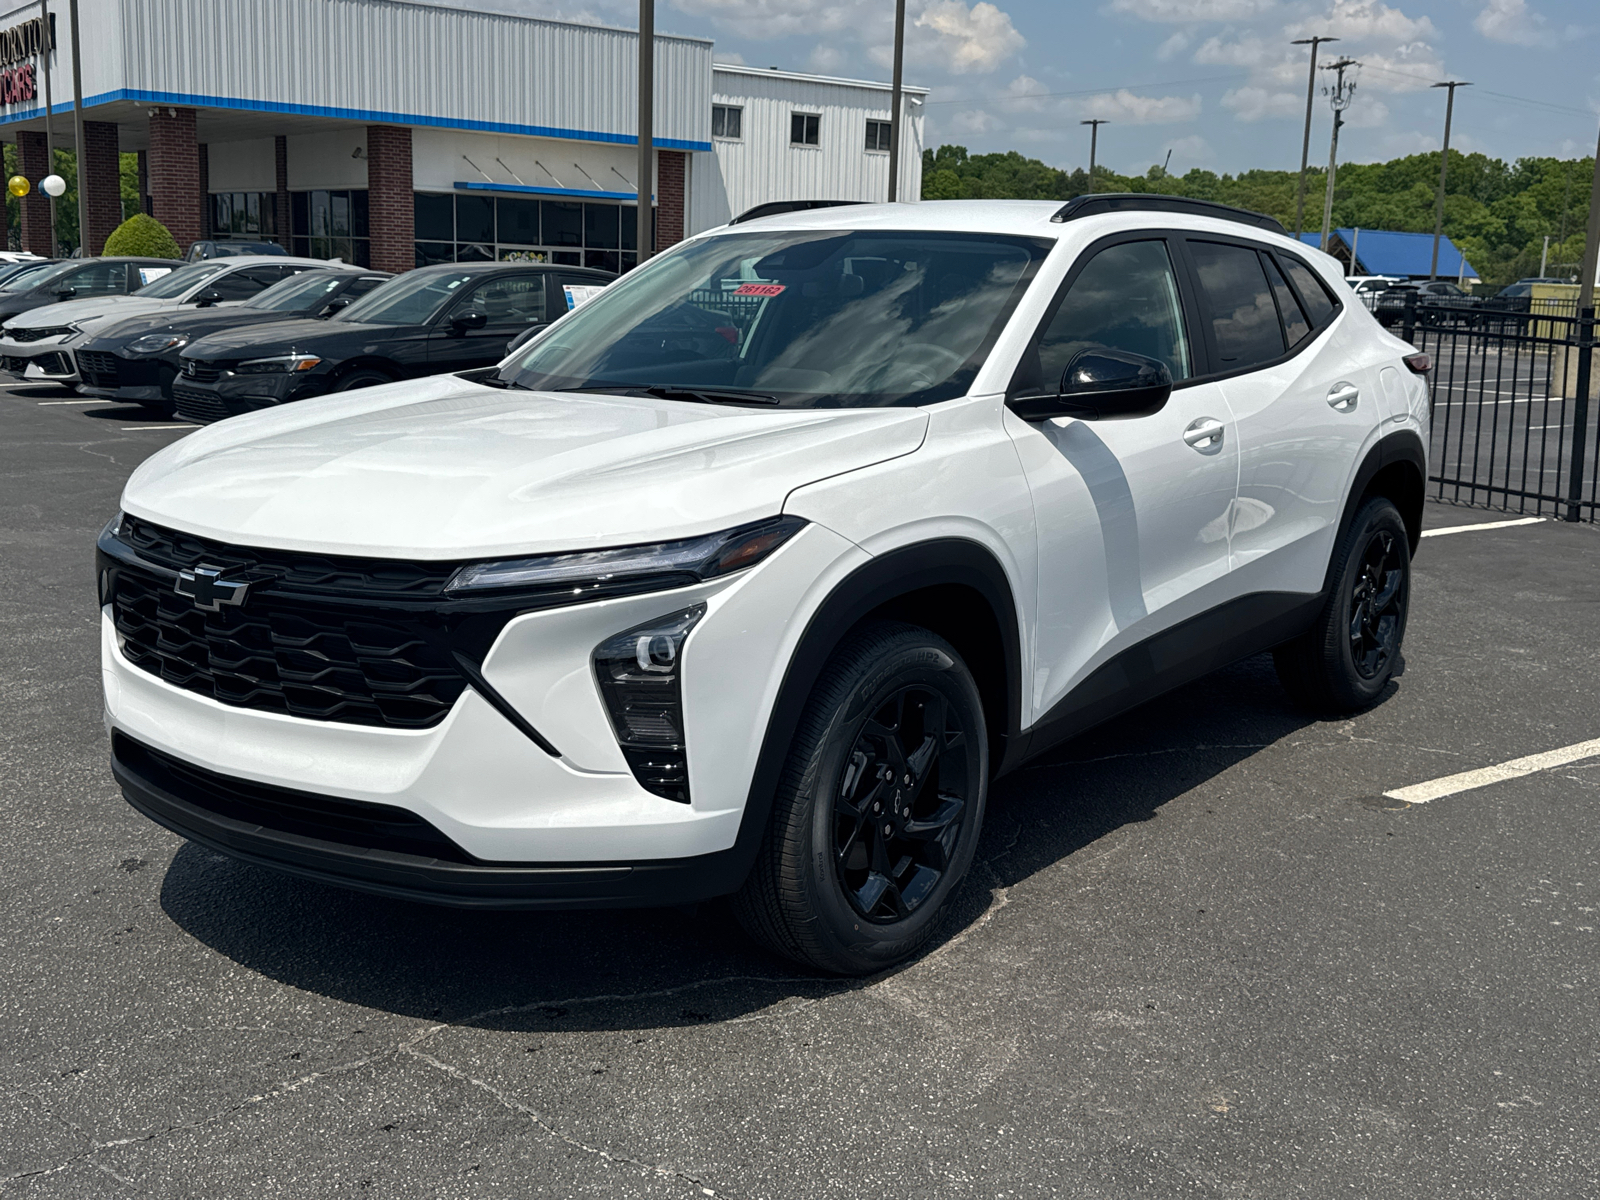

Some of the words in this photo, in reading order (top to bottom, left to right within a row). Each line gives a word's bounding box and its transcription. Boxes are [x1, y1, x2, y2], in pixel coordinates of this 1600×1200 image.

[0, 12, 55, 66] ORNTON
[3, 63, 34, 105] CARS
[737, 285, 781, 295] 261162
[860, 655, 912, 702] Dynapro
[916, 651, 940, 663] HP2
